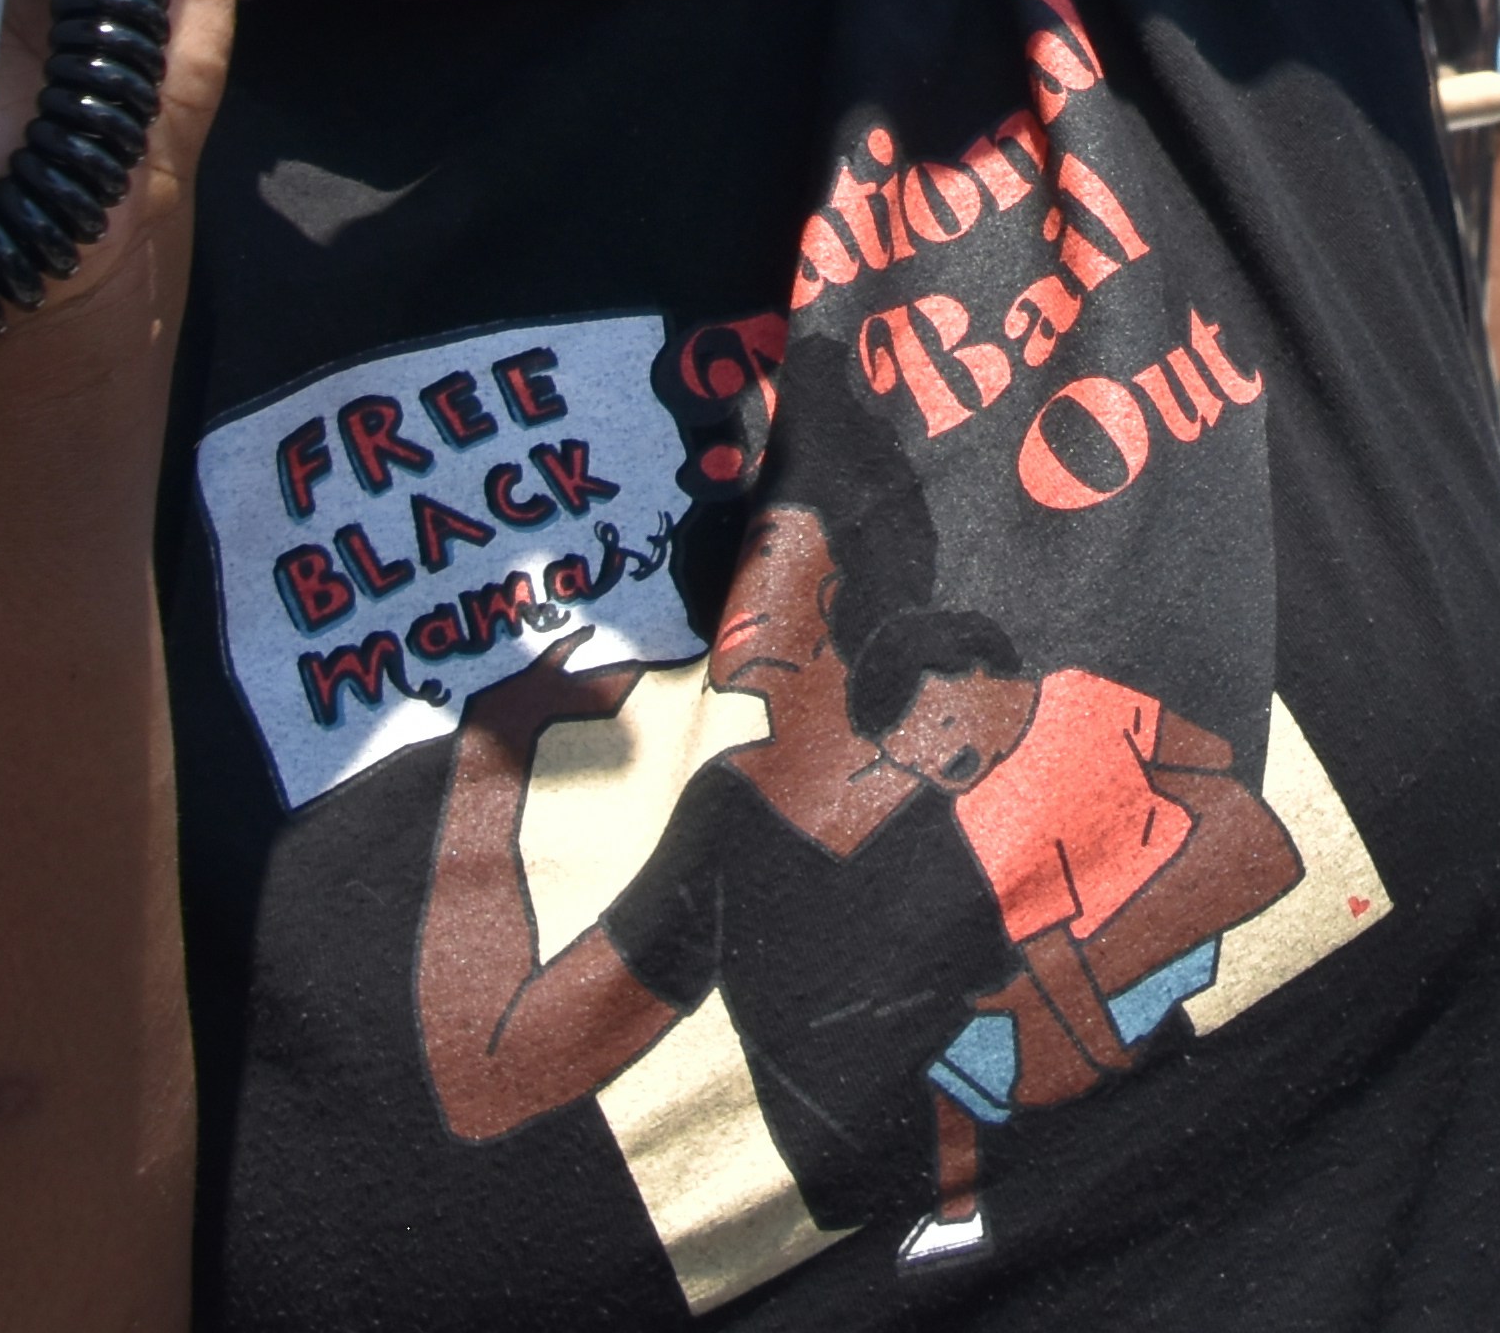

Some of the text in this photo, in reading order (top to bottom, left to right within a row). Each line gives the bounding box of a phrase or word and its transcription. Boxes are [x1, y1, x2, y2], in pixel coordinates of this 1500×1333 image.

[858, 153, 1151, 439] Bail
[276, 346, 569, 527] FREE
[1016, 307, 1266, 511] Out
[273, 438, 621, 635] BLACK
